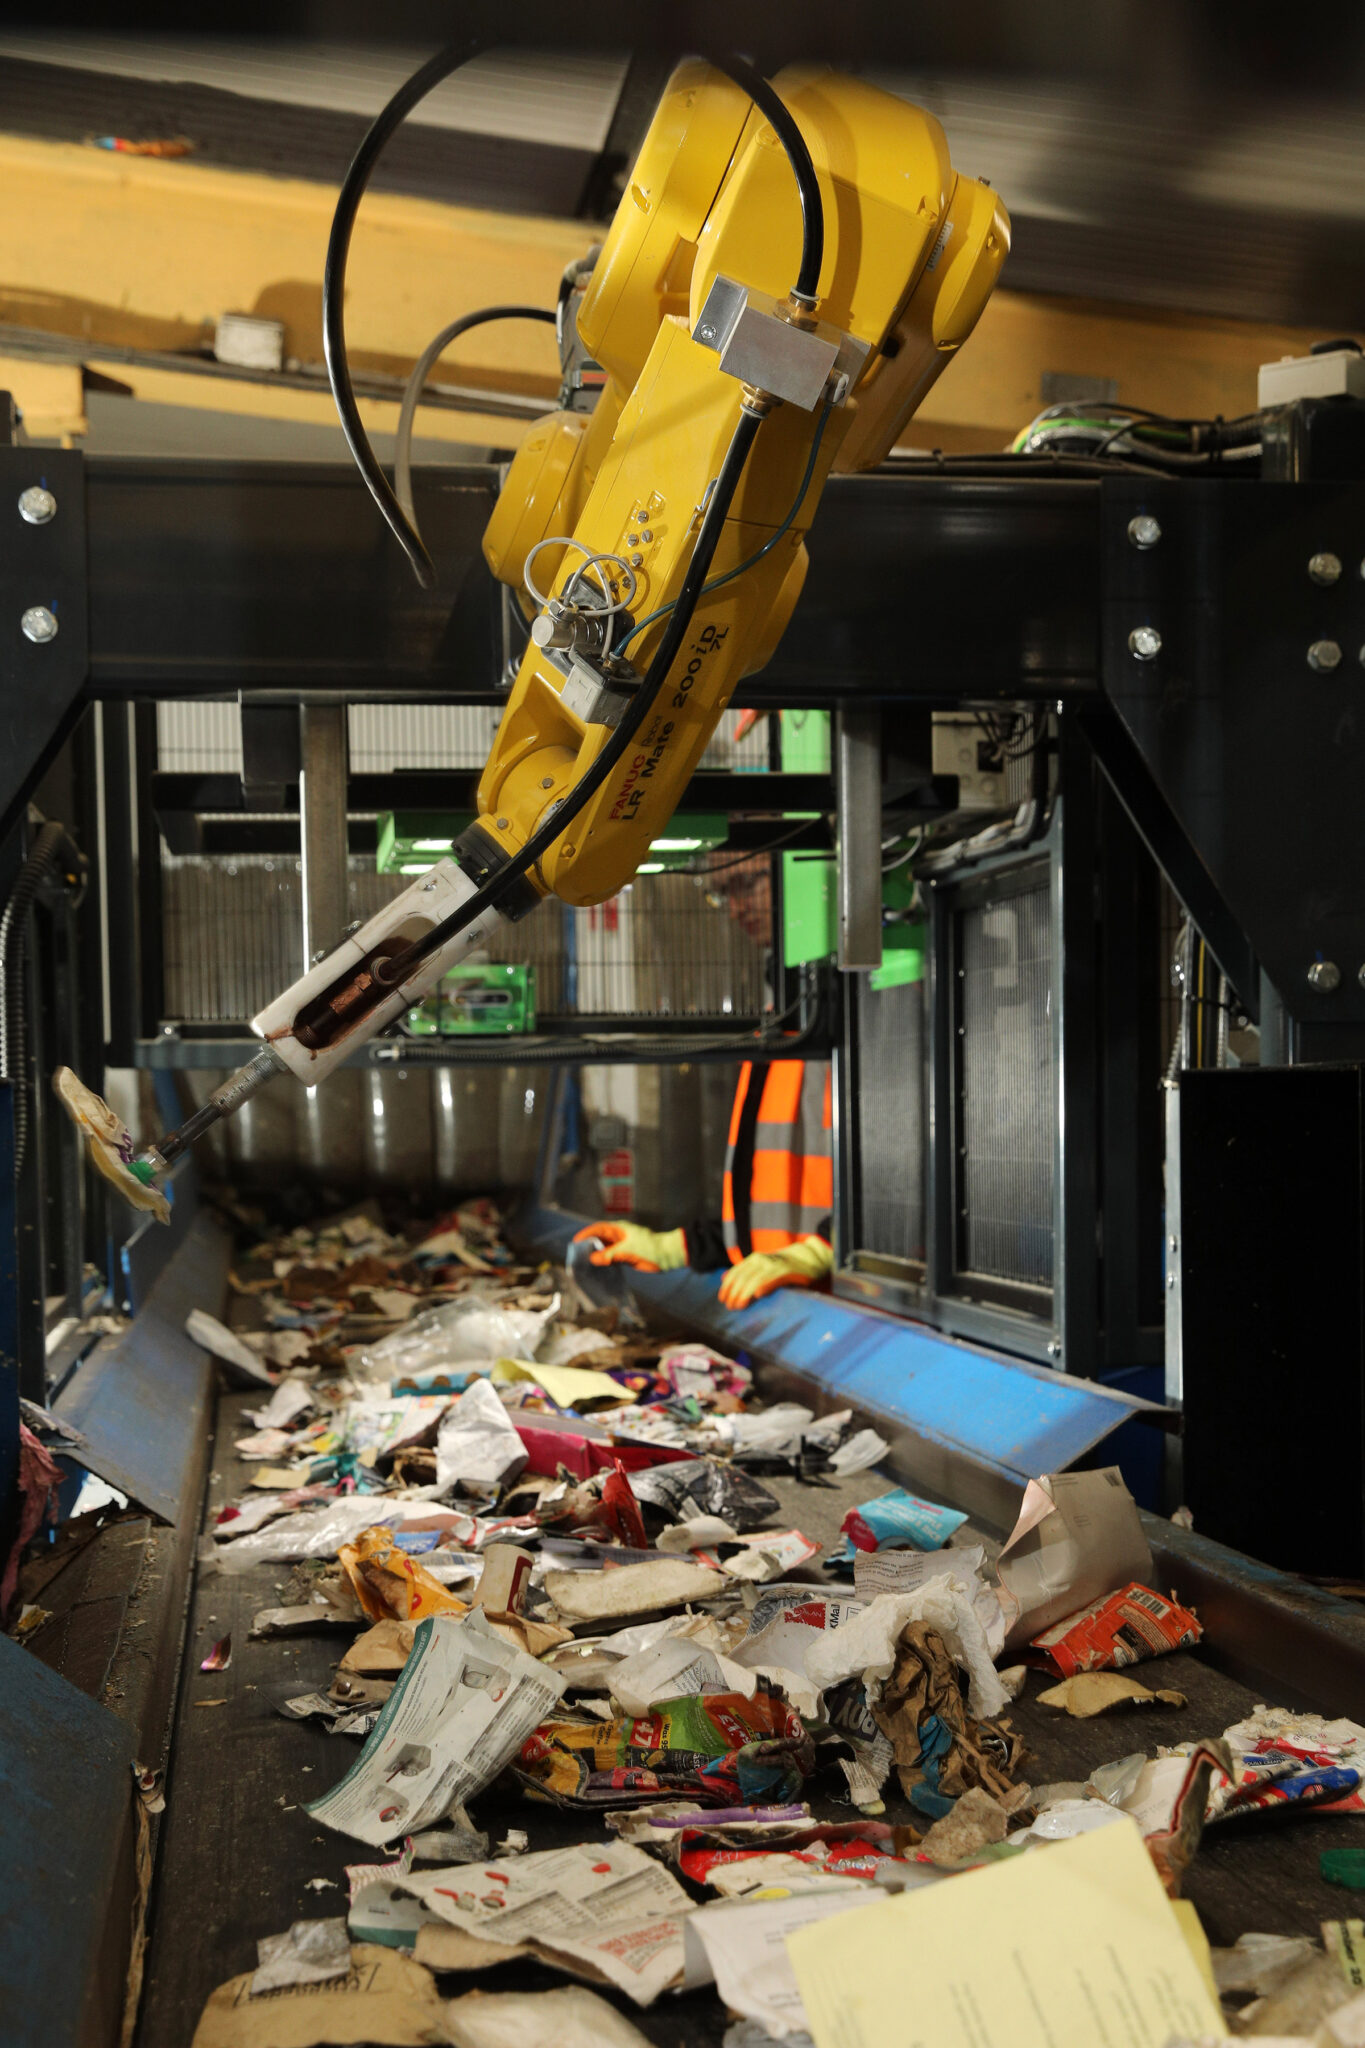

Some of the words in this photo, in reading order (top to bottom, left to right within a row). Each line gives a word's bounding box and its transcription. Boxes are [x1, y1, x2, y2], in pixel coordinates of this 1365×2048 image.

[608, 754, 646, 821] FANUC
[641, 715, 662, 747] Robot
[622, 789, 646, 821] LR
[640, 720, 675, 778] Mate
[662, 1723, 670, 1737] Was
